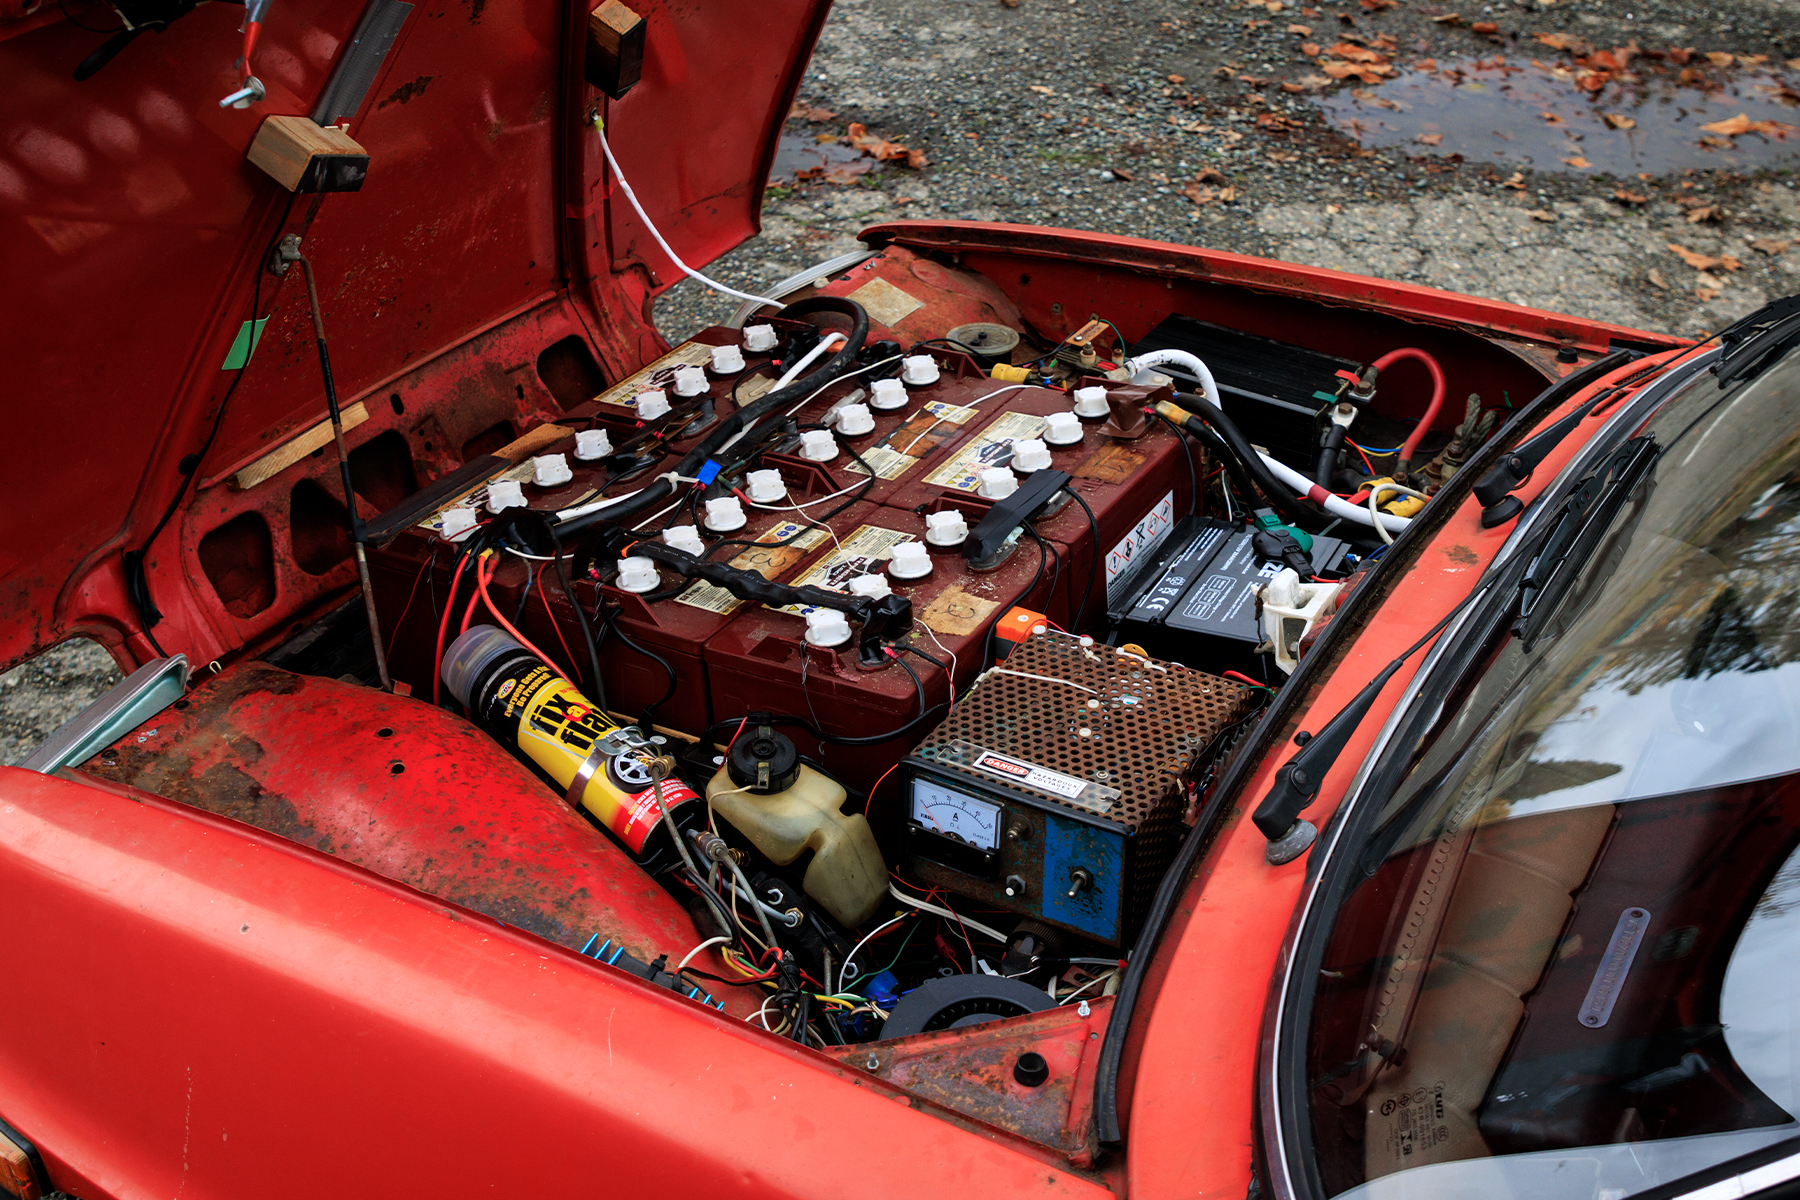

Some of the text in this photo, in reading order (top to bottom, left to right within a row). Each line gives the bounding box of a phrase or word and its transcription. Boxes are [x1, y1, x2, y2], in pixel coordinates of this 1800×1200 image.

[1107, 568, 1126, 590] DANGER
[504, 684, 526, 718] Everyone
[520, 672, 538, 684] Gets
[516, 696, 527, 708] Be
[530, 692, 576, 736] fix
[986, 758, 1028, 775] DANGER
[952, 812, 959, 820] A
